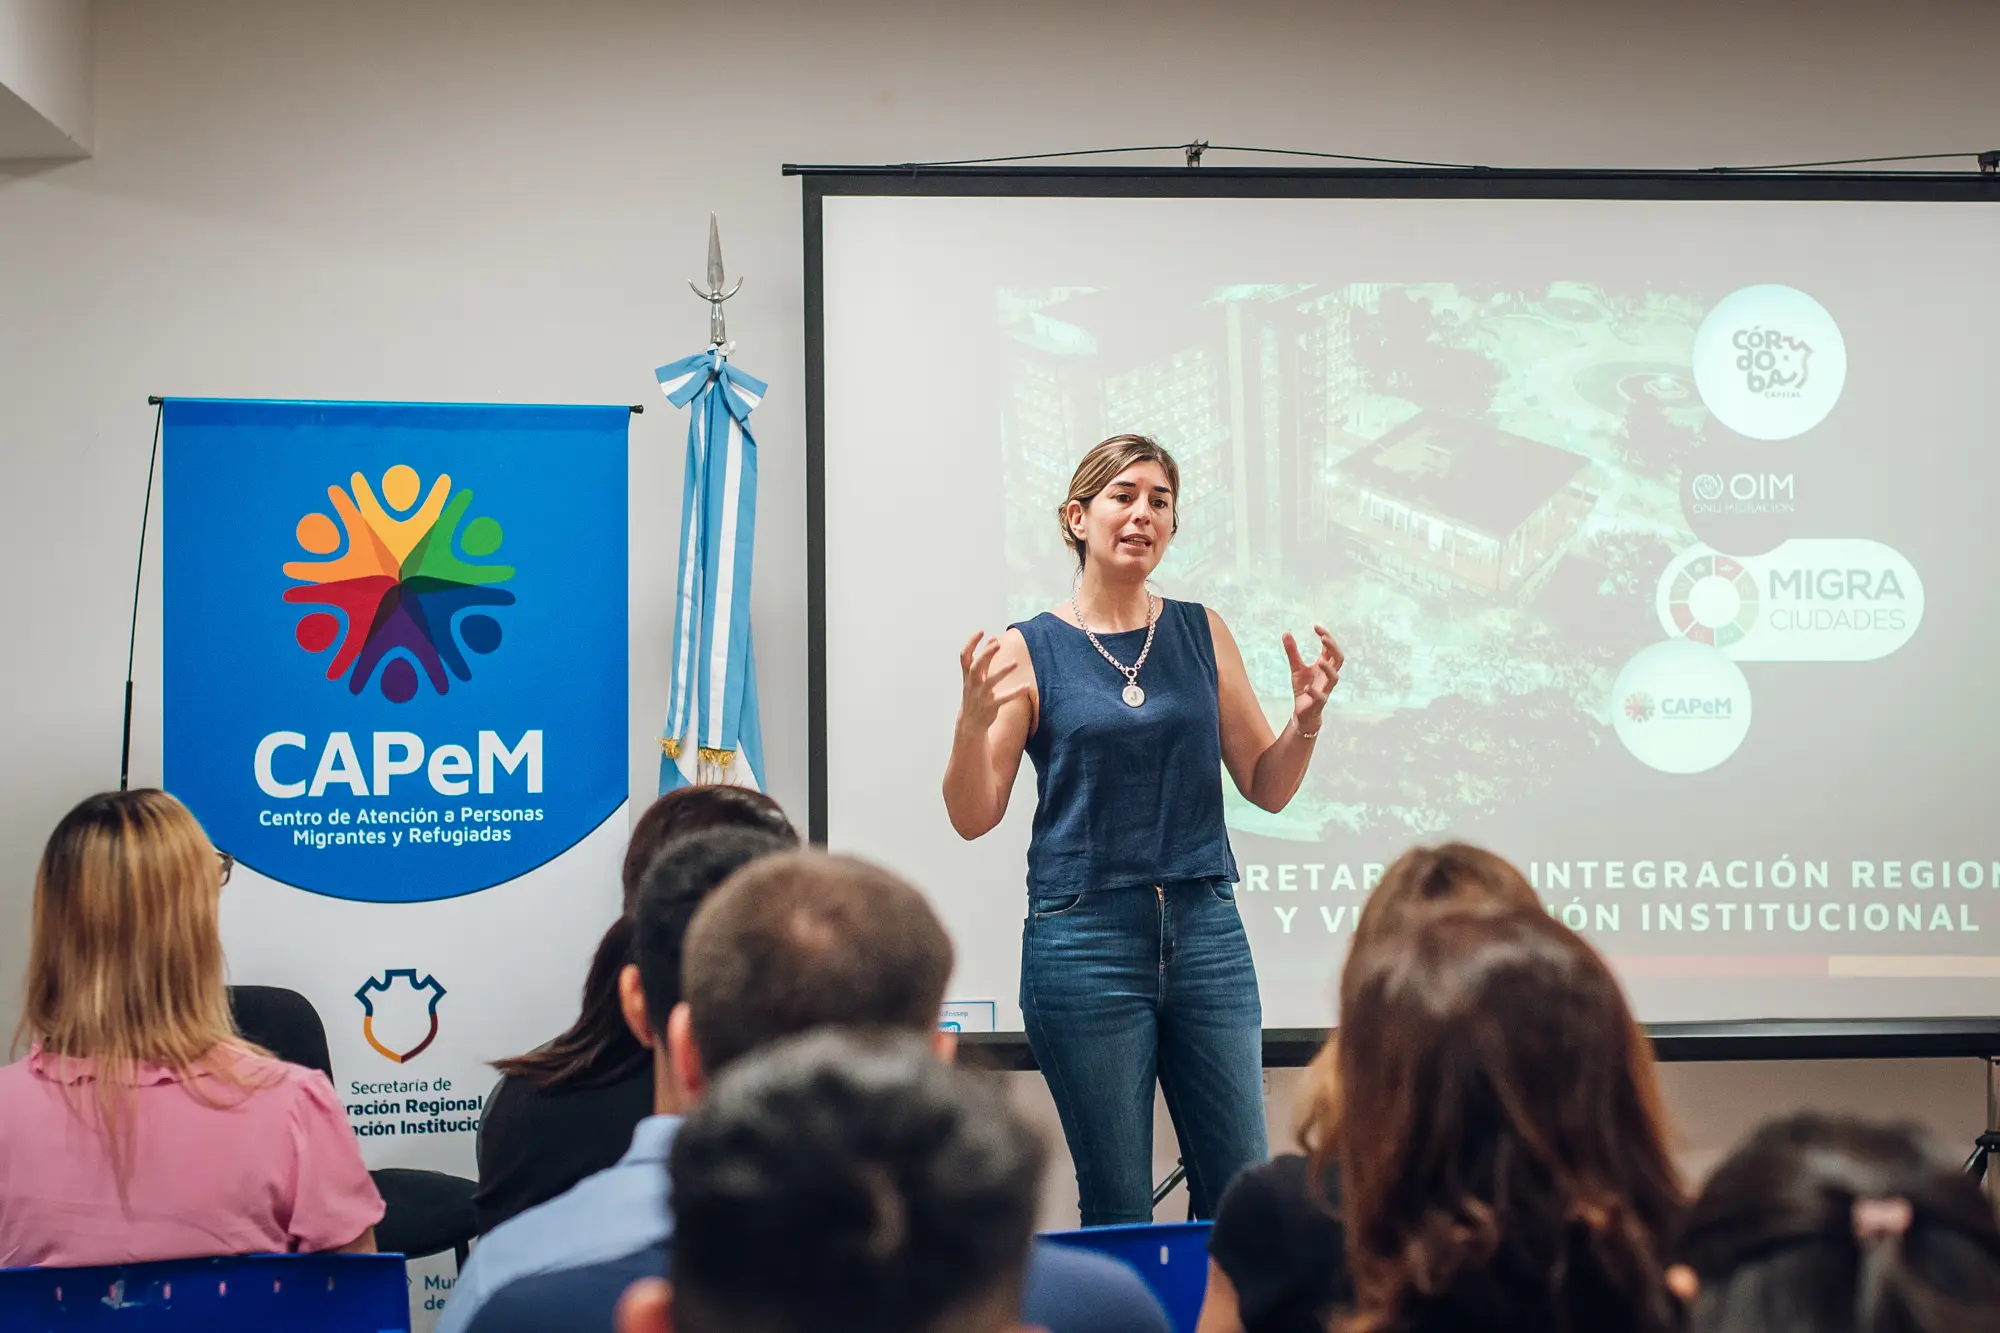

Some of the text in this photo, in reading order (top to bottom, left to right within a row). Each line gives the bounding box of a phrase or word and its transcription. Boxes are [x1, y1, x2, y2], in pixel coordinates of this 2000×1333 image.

[1730, 473, 1794, 500] OIM
[1770, 568, 1905, 600] MIGRA
[1770, 609, 1906, 631] CIUDADES
[1661, 697, 1732, 714] CAPeM
[254, 730, 543, 798] CAPeM
[259, 806, 544, 826] Centro de Atención a Personas
[293, 825, 512, 849] Migrantes y Refugiadas
[1233, 863, 1385, 891] RETAR
[1530, 854, 1829, 889] INTEGRACIÓN
[1273, 906, 1298, 933] Y
[1641, 903, 1980, 932] INSTITUCIONAL
[351, 1077, 452, 1095] Secretaría de
[343, 1095, 482, 1116] ración Regional
[424, 1294, 446, 1311] de
